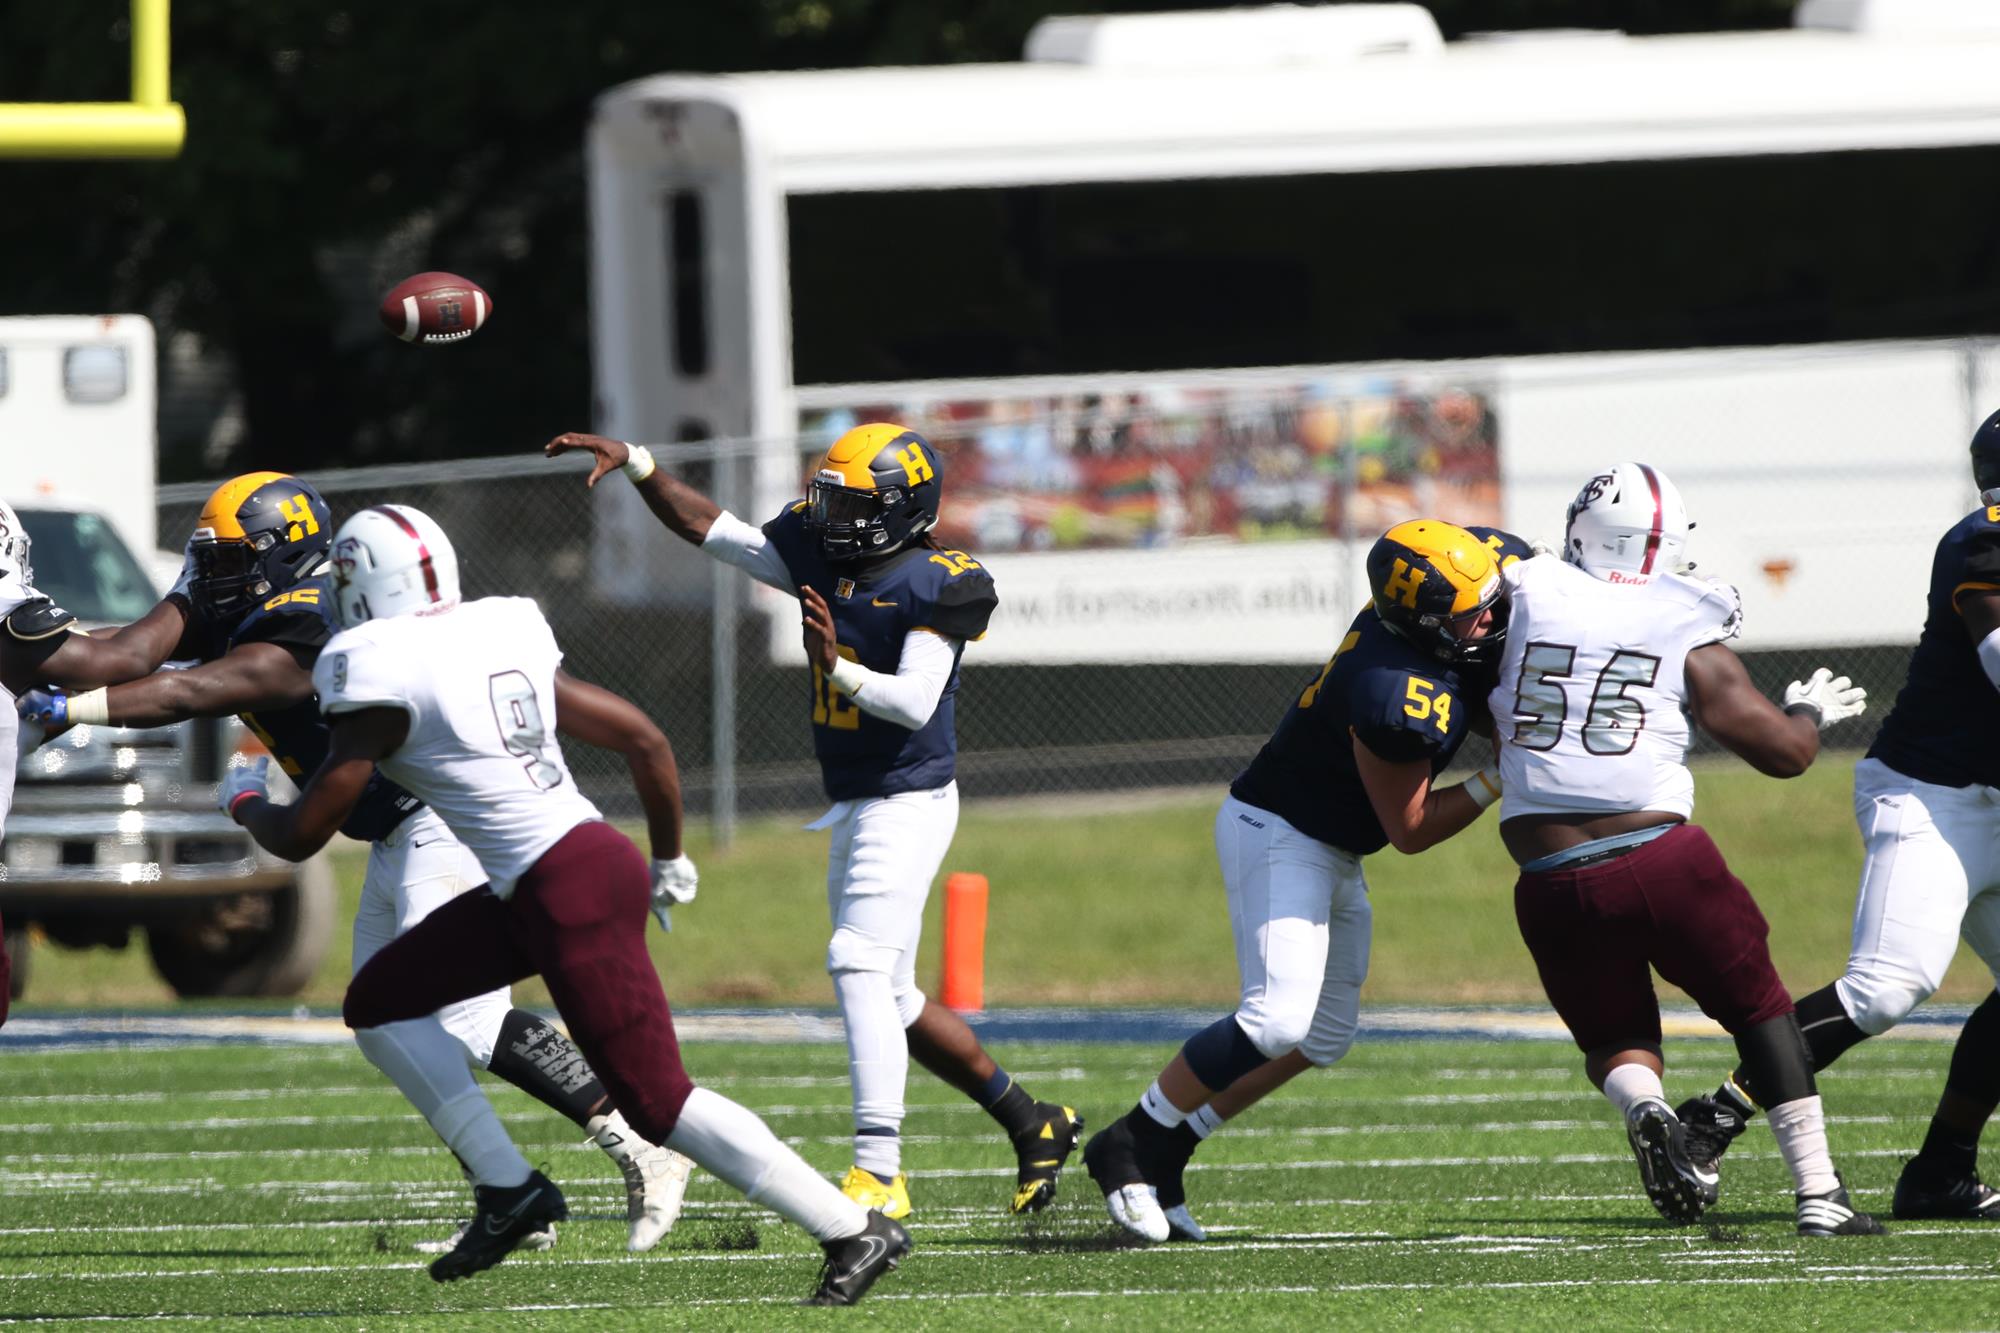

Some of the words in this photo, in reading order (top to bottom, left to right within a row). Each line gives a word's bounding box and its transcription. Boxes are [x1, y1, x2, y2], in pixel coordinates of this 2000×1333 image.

[895, 441, 935, 488] H
[277, 494, 320, 543] H
[929, 550, 981, 577] 12
[1384, 557, 1427, 609] H
[333, 653, 349, 693] 9
[1404, 676, 1452, 734] 54
[1509, 641, 1663, 756] 56
[488, 669, 563, 792] 9
